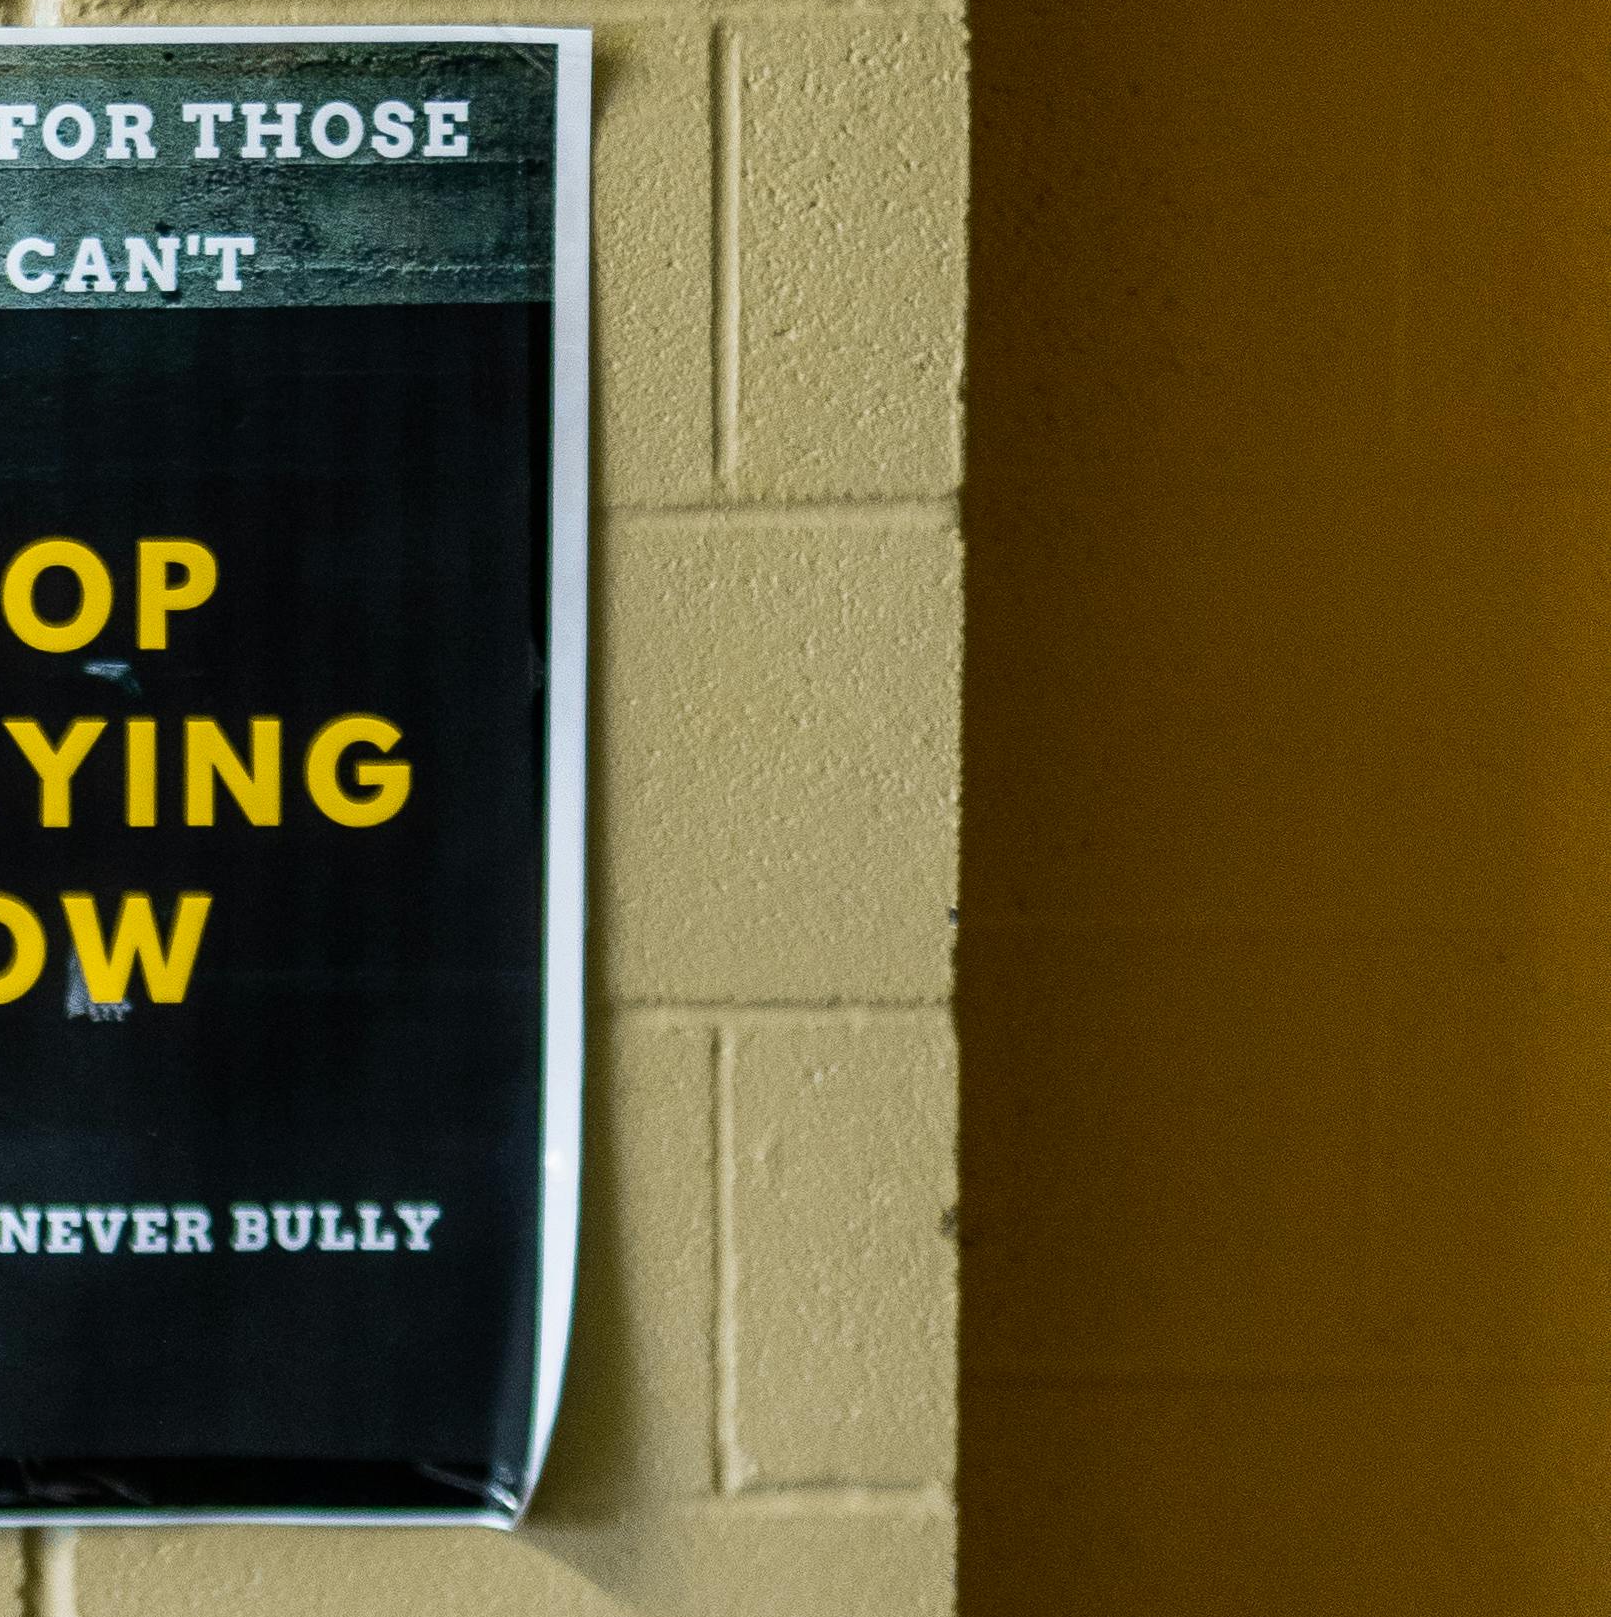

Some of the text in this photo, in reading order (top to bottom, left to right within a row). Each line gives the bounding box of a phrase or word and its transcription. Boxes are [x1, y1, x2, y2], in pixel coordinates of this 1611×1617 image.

[182, 101, 470, 161] THOSE
[4, 234, 257, 296] CAN'T
[234, 1205, 442, 1253] BULLY
